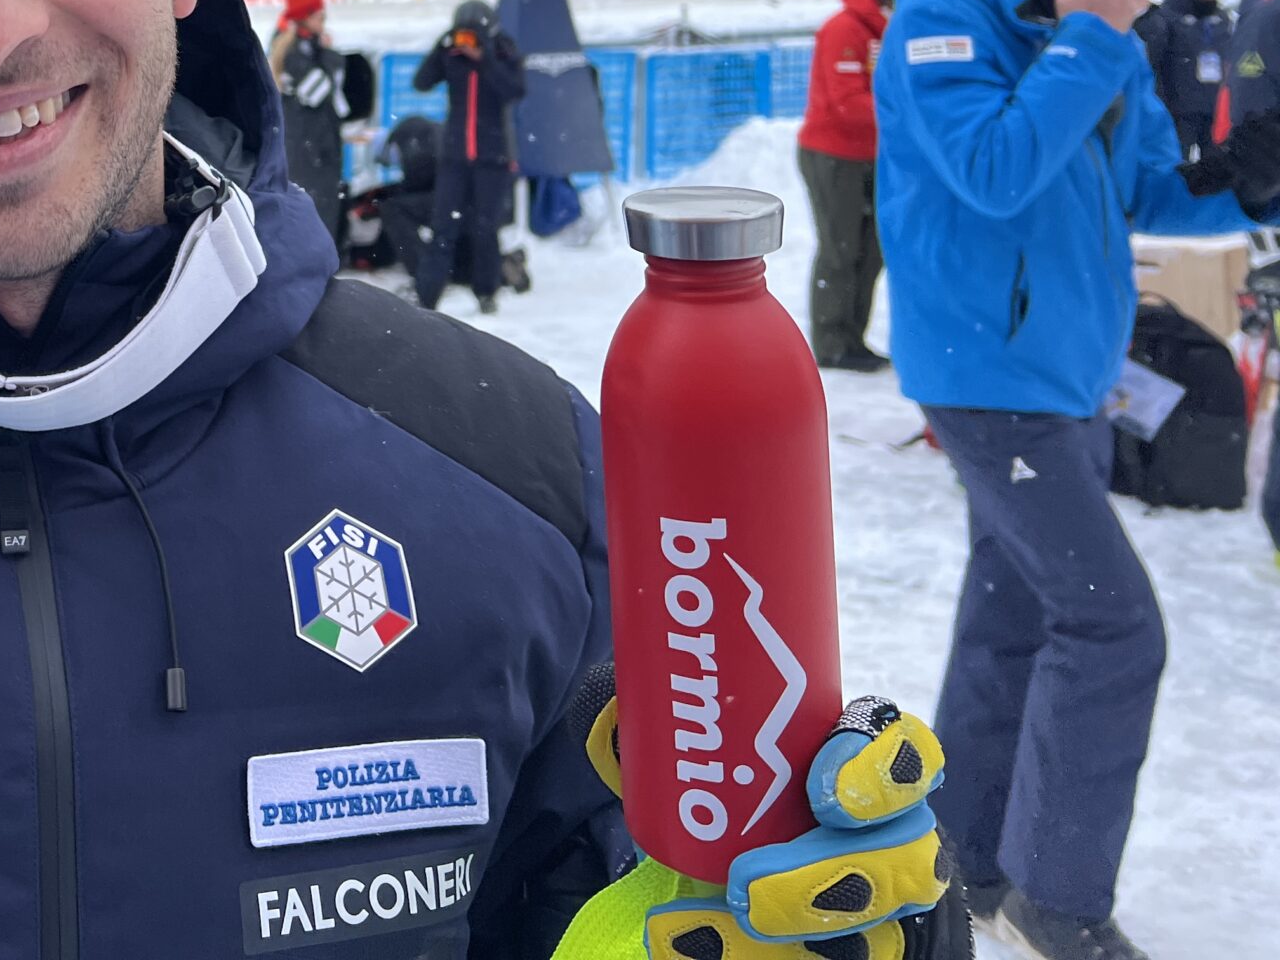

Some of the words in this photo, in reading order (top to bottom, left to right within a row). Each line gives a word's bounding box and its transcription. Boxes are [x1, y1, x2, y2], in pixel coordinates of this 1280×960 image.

[4, 535, 27, 547] EA7
[307, 524, 379, 560] FISI
[658, 516, 754, 841] bormio
[315, 757, 420, 791] POLIZIA
[260, 784, 478, 827] PENITENZIARIA
[257, 853, 475, 939] FALCONERI
